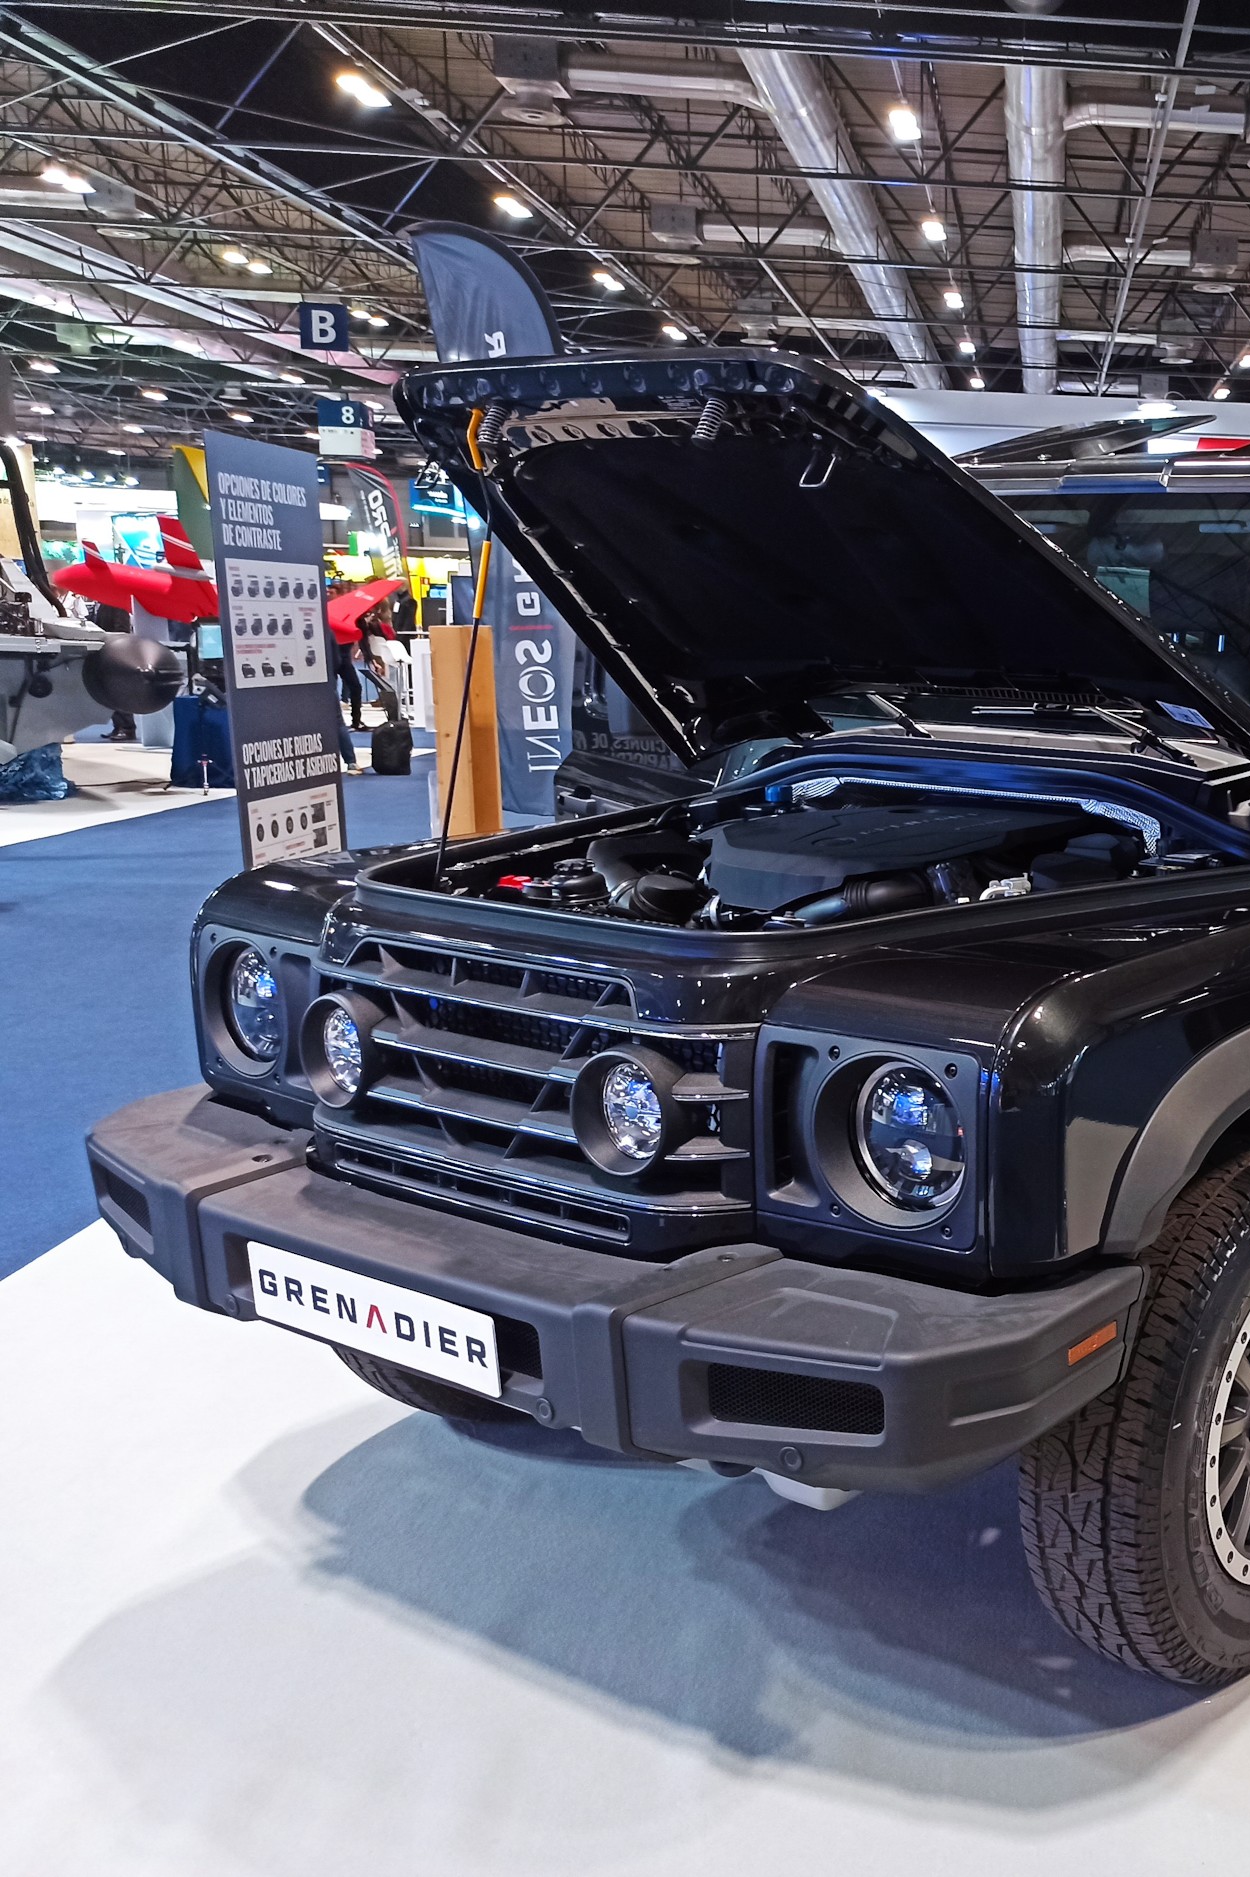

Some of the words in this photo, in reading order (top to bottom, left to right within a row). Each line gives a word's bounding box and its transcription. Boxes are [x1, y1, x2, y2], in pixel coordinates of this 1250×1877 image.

[311, 309, 337, 344] B
[341, 405, 355, 425] 8
[217, 471, 261, 502] OPCIONES
[261, 479, 273, 502] DE
[271, 481, 307, 508] COLORES
[219, 497, 227, 520] Y
[227, 498, 275, 527] ELEMENTOS
[221, 523, 236, 546] DE
[235, 525, 283, 551] CONTRASTE
[242, 738, 282, 766] OPCIONES
[283, 737, 294, 758] DE
[294, 732, 323, 756] RUEDAS
[243, 767, 251, 790] Y
[295, 758, 306, 780] DE
[305, 752, 339, 778] ASIENTOS
[258, 1268, 488, 1369] GRENADIER
